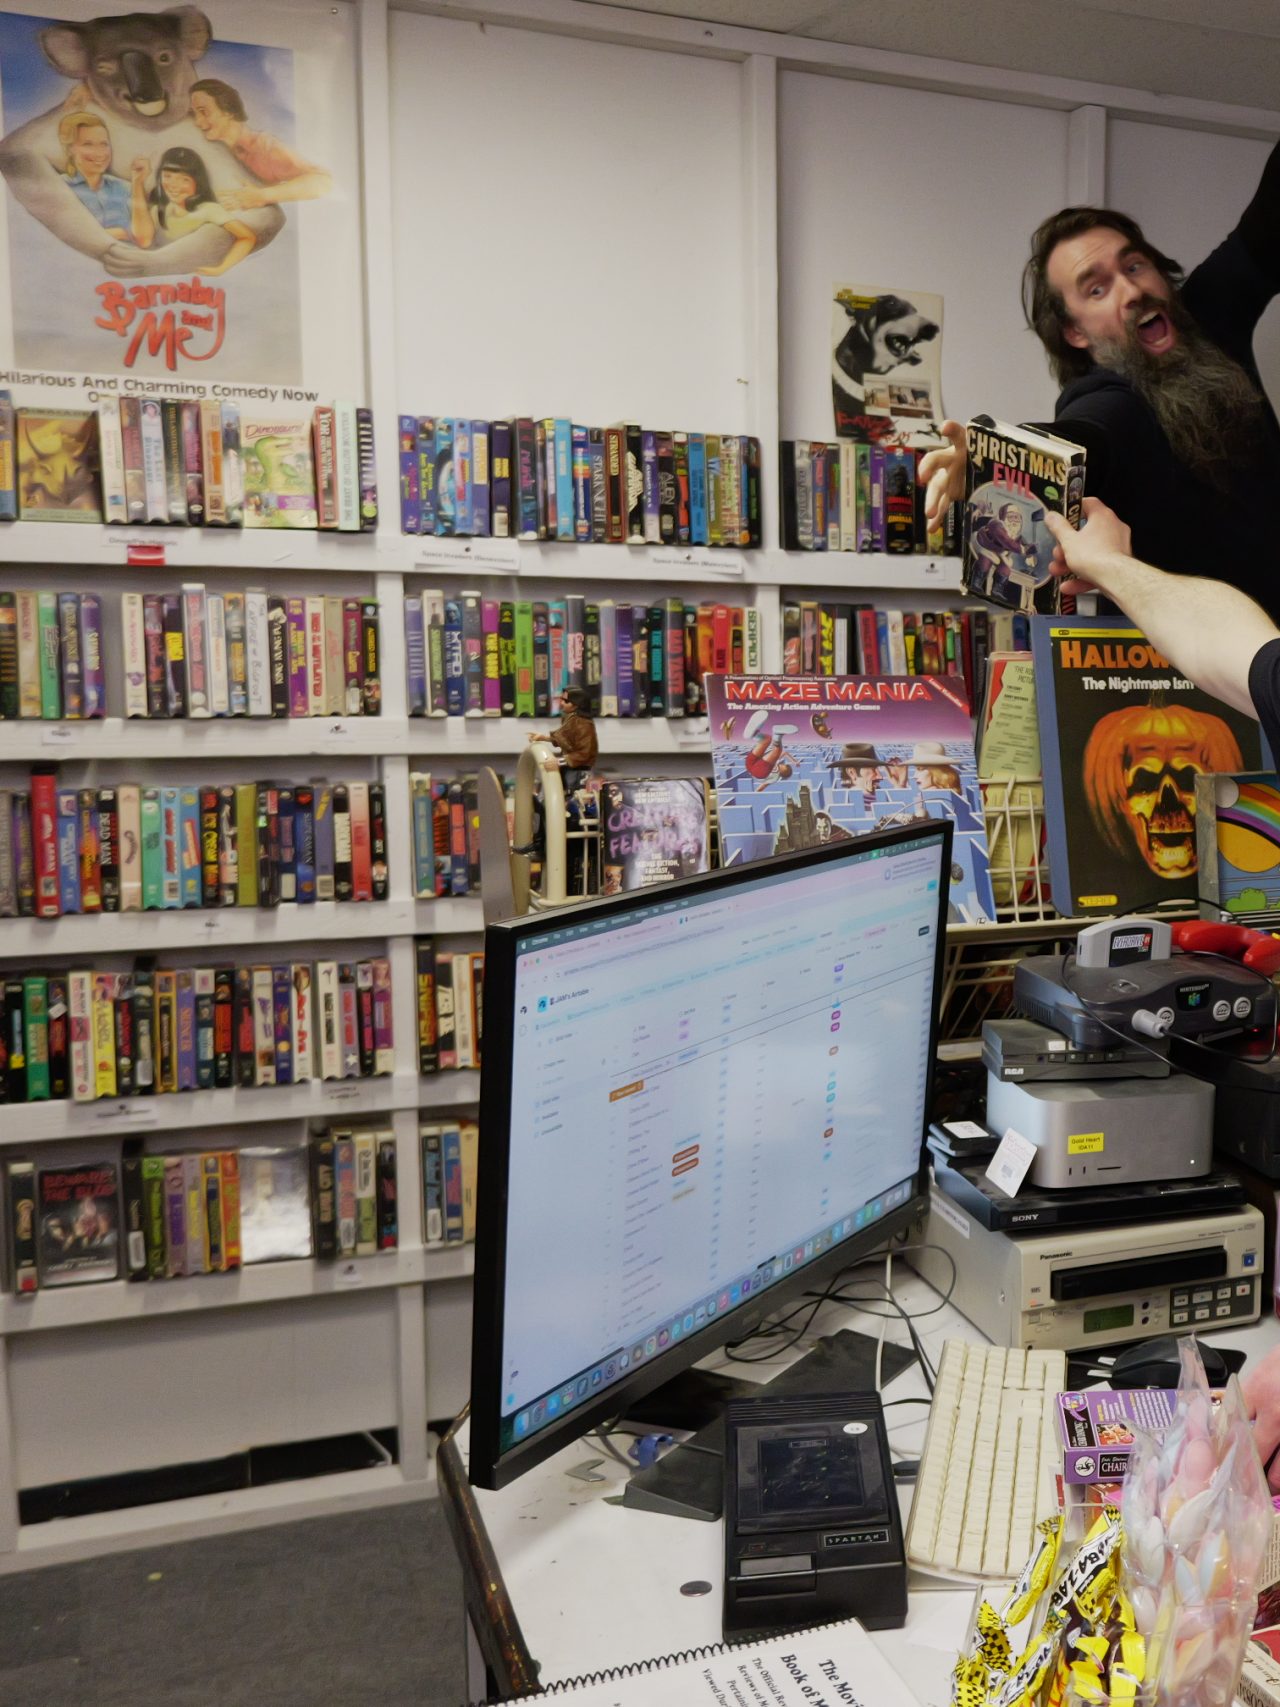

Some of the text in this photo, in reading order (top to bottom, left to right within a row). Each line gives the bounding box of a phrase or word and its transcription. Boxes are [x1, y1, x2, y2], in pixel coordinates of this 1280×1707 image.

[95, 276, 225, 342] Barnaby
[123, 309, 193, 371] Me
[83, 376, 118, 390] And
[125, 378, 207, 398] Charming
[212, 384, 279, 402] Comedy
[283, 387, 319, 402] Now
[609, 434, 619, 475] STRANDED
[967, 428, 1066, 485] CHRISTMAS
[665, 472, 674, 505] ALIEN
[993, 462, 1036, 500] EVIL
[486, 633, 498, 679] THE DARK
[574, 633, 584, 669] Galaxy
[748, 611, 758, 667] SERPICO
[1060, 640, 1169, 668] HALLOW
[668, 629, 684, 695] BAD TASTE
[724, 681, 932, 701] MAZE MANIA
[1082, 676, 1194, 693] The Nightmare Isn
[744, 703, 780, 711] Amazing
[782, 703, 805, 711] Action
[100, 812, 112, 865] DEAD MAN
[203, 831, 218, 862] CREAM
[303, 813, 313, 864] SUPERMAN
[418, 973, 436, 1046] SNIPER
[1012, 1214, 1039, 1222] SONY
[1040, 1251, 1073, 1260] Panasonic
[1101, 1463, 1128, 1472] CHAIR
[701, 1668, 721, 1694] Viewed
[737, 1664, 757, 1692] Reviews
[752, 1658, 780, 1698] The Official
[781, 1654, 821, 1698] Book of
[818, 1659, 864, 1707] The Movi
